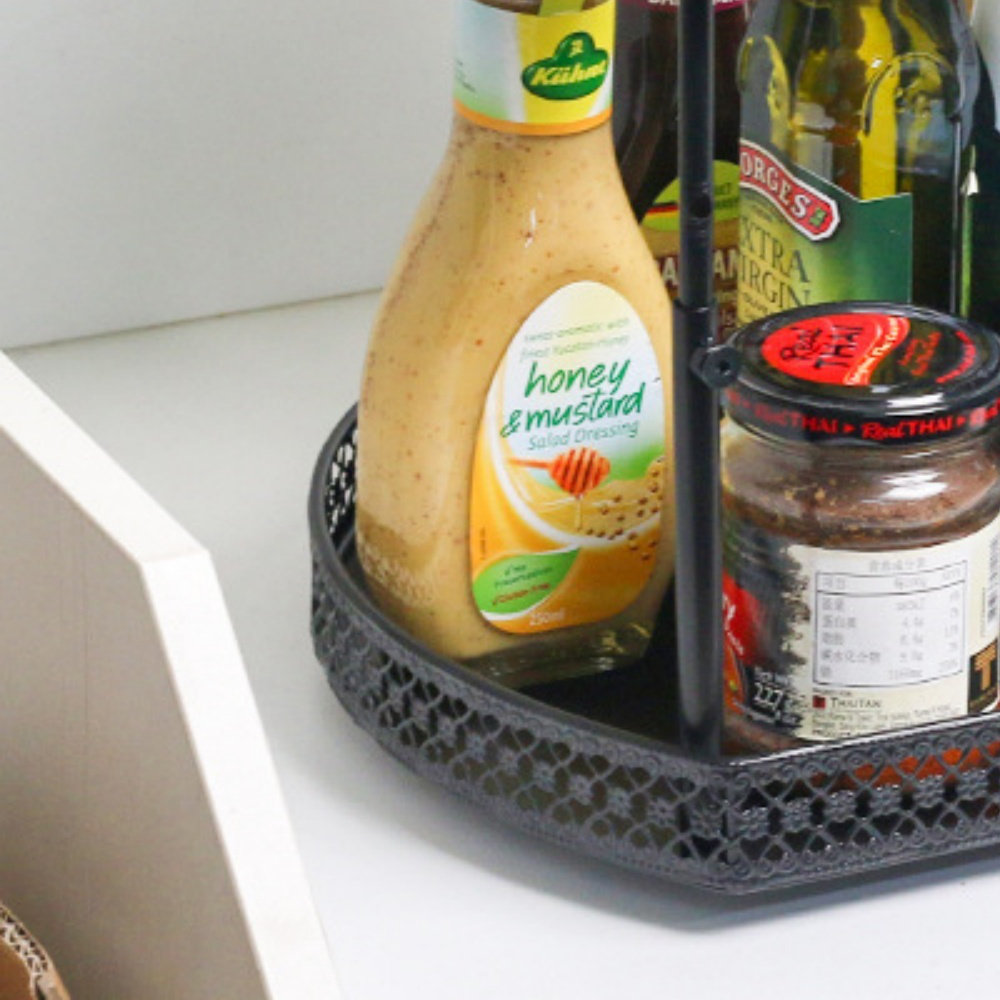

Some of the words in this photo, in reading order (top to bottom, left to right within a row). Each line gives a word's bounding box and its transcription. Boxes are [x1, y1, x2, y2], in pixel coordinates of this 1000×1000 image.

[741, 152, 812, 219] ORGES
[741, 217, 811, 283] XTRA
[741, 254, 811, 309] IRGIN
[524, 358, 631, 398] honey
[528, 430, 570, 450] Salad
[574, 420, 640, 444] Dressing
